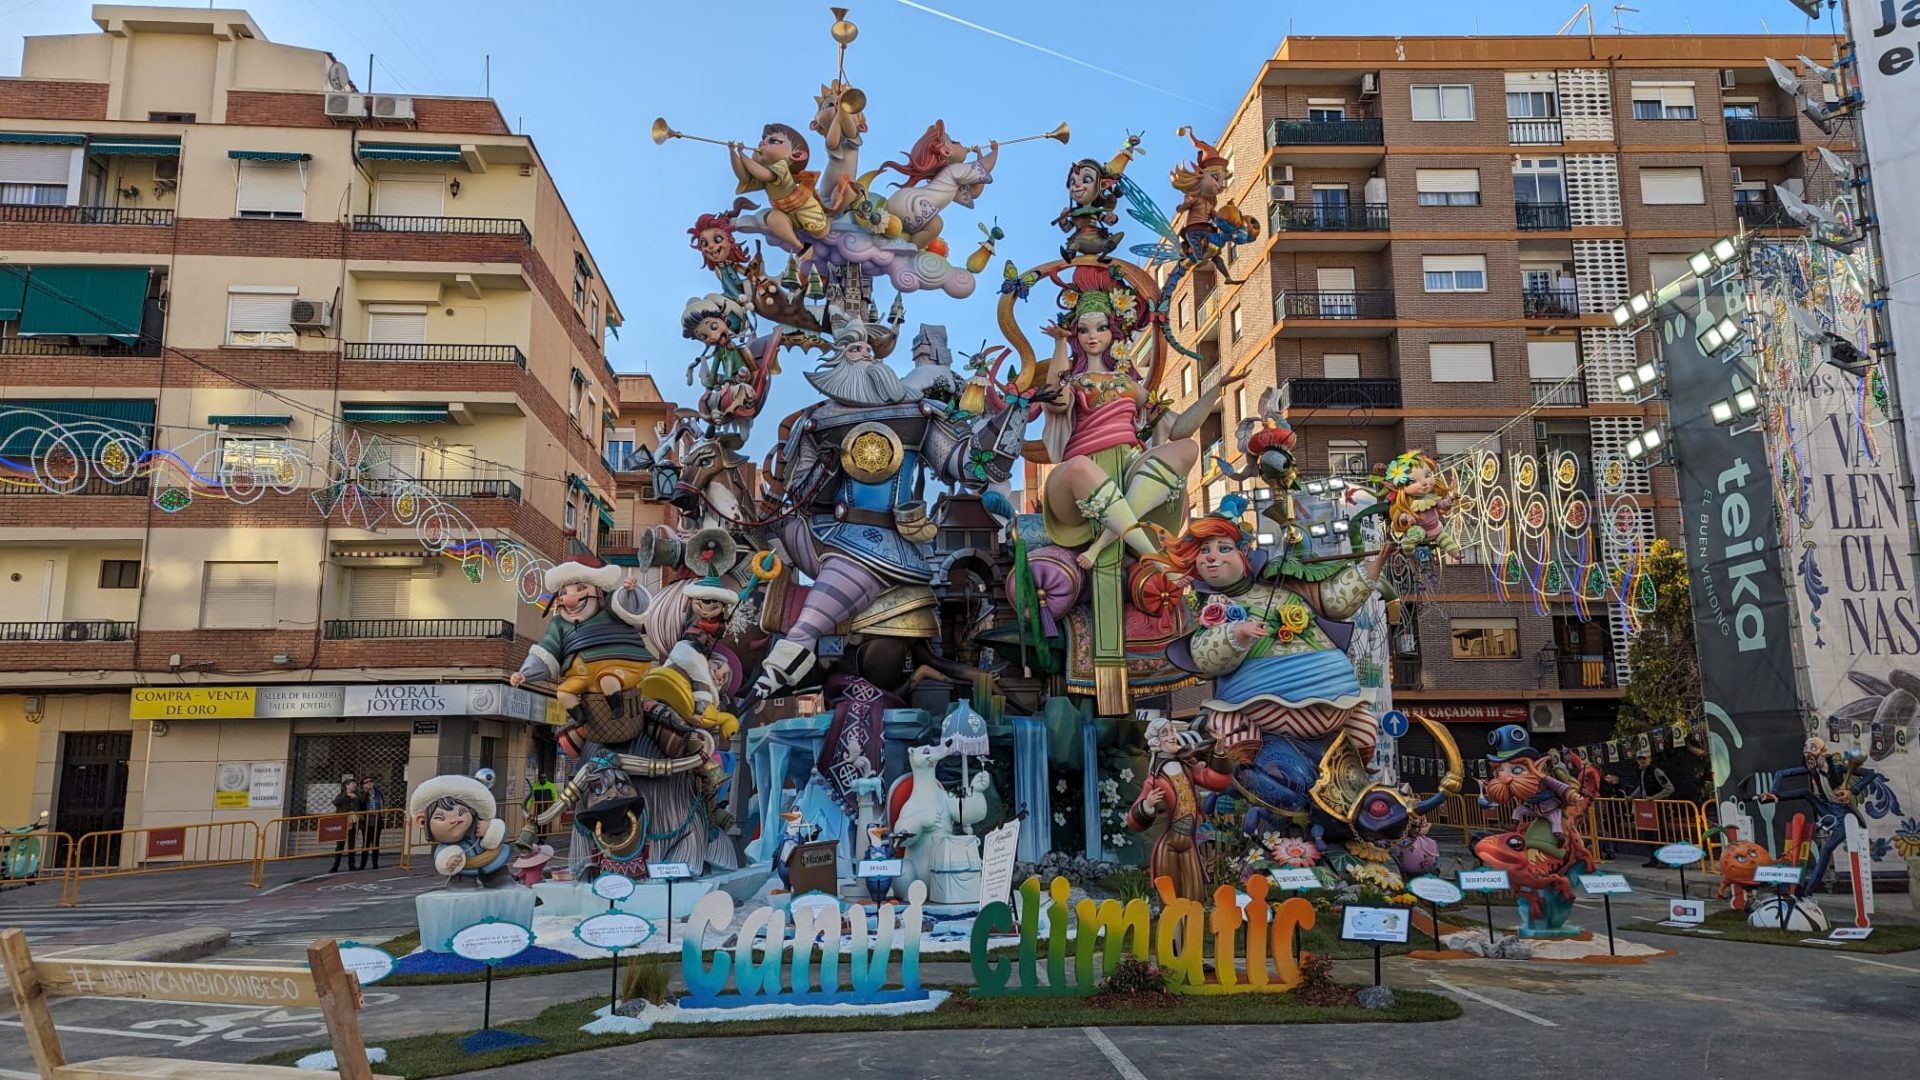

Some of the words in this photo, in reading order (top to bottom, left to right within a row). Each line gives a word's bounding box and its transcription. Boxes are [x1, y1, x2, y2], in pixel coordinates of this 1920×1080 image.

[1702, 489, 1712, 506] EL
[1824, 472, 1900, 530] LEN
[1698, 514, 1709, 557] BUEN
[1717, 457, 1767, 652] teika
[1840, 534, 1908, 593] CIA
[1701, 563, 1731, 637] VENDING
[1840, 596, 1920, 656] NAS
[135, 691, 192, 702] COMPRA
[207, 690, 250, 701] VENTA
[260, 691, 287, 701] TALLER
[288, 691, 300, 700] DE
[374, 686, 440, 699] MORAL
[166, 705, 185, 715] DE
[187, 705, 217, 715] ORO
[268, 702, 296, 711] TALLER
[367, 698, 446, 714] JOYEROS
[1428, 706, 1484, 719] CAÇADOR
[1486, 706, 1500, 717] III
[682, 880, 928, 997] Canvi
[971, 874, 1316, 991] climàtic
